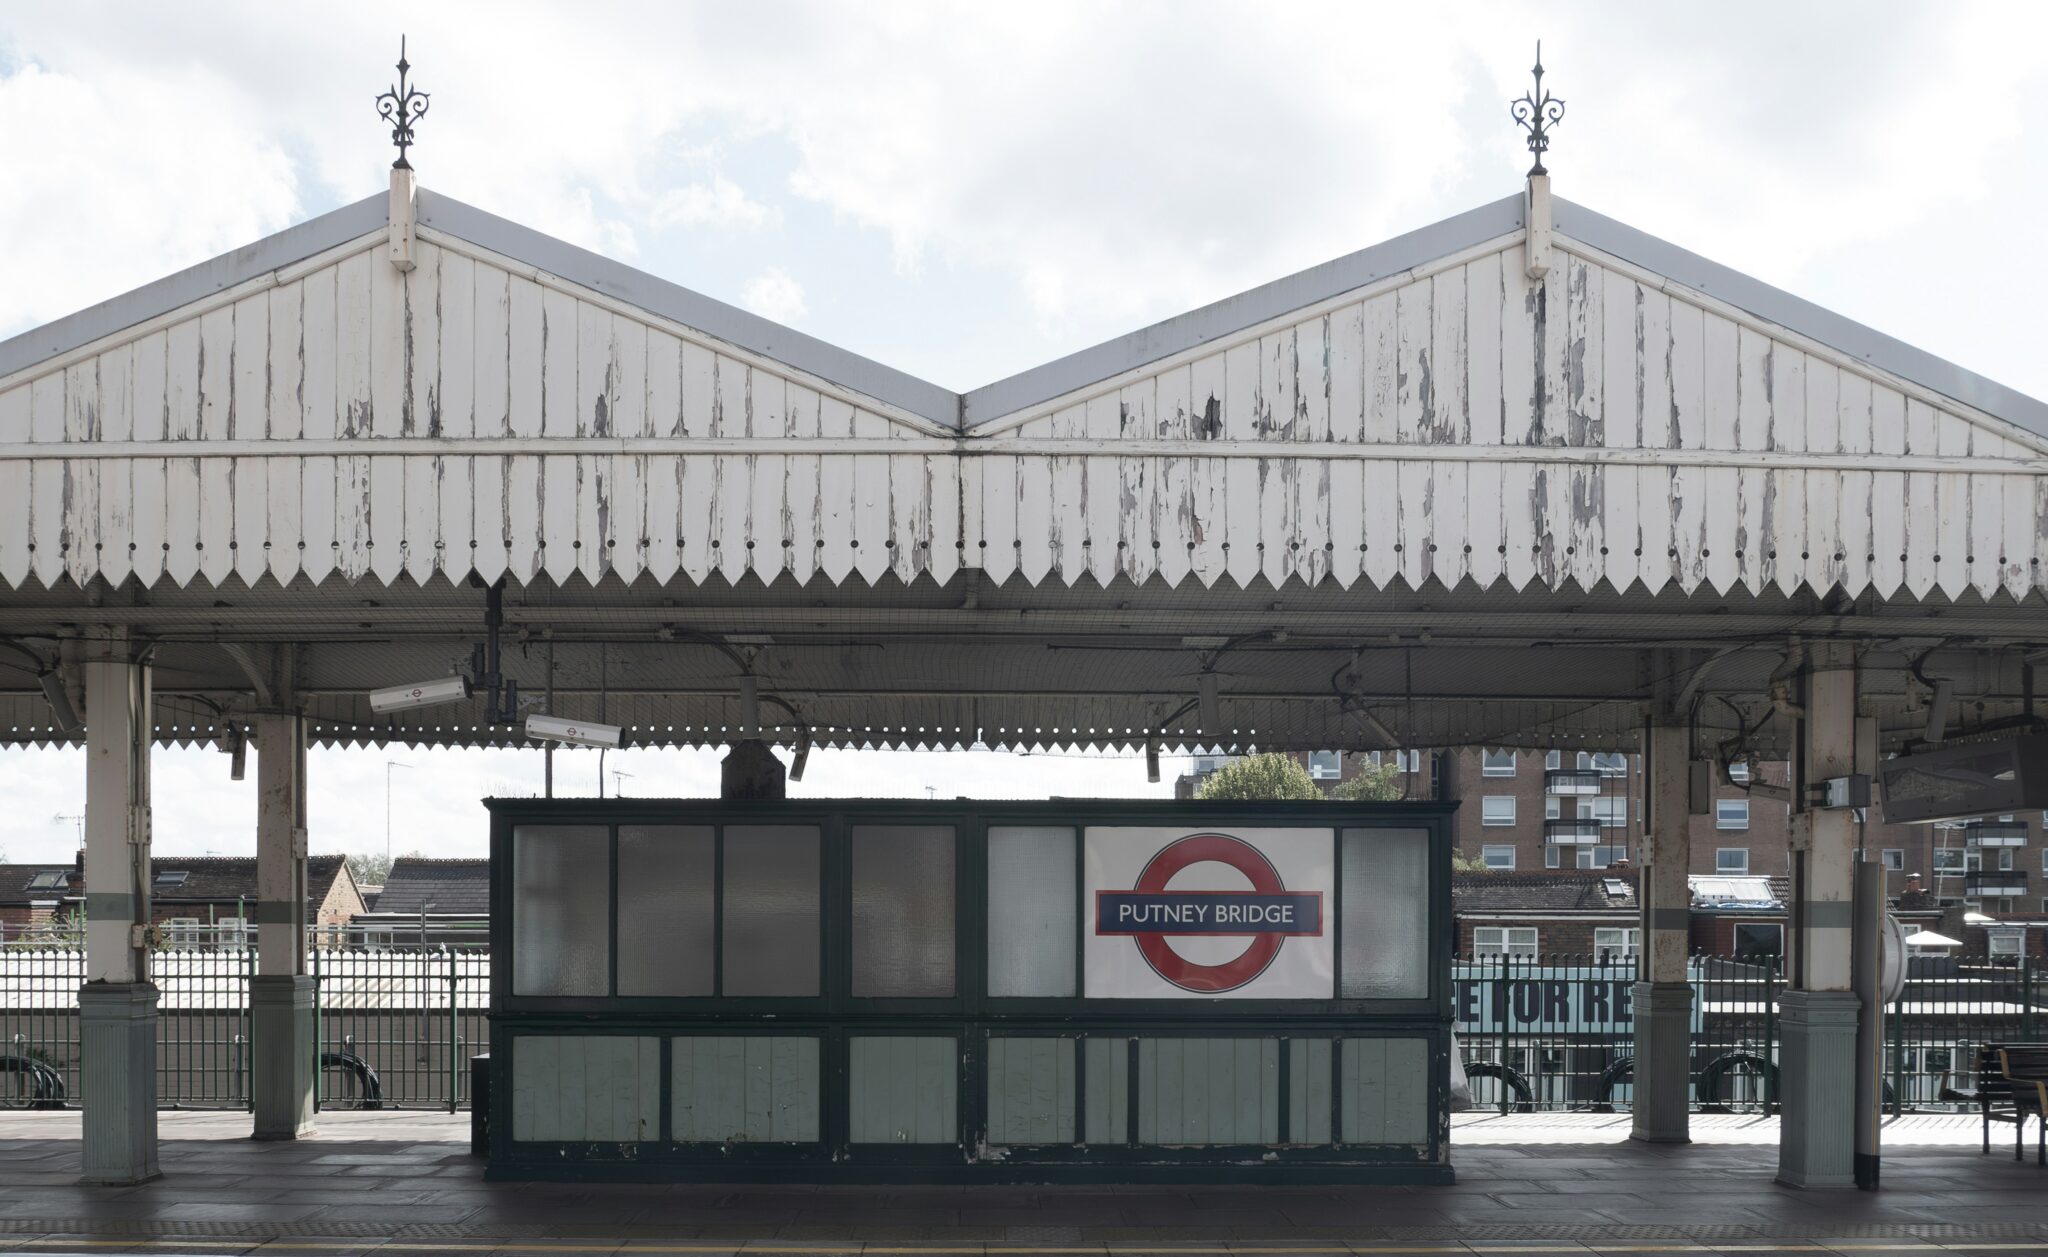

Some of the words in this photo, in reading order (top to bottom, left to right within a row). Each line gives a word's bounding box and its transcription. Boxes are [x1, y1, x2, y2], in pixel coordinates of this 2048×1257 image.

[1119, 904, 1209, 923] PUTNEY
[1215, 905, 1294, 923] BRIDGE
[1451, 981, 1480, 1023] E
[1491, 981, 1570, 1023] FOR
[1583, 981, 1633, 1023] RE
